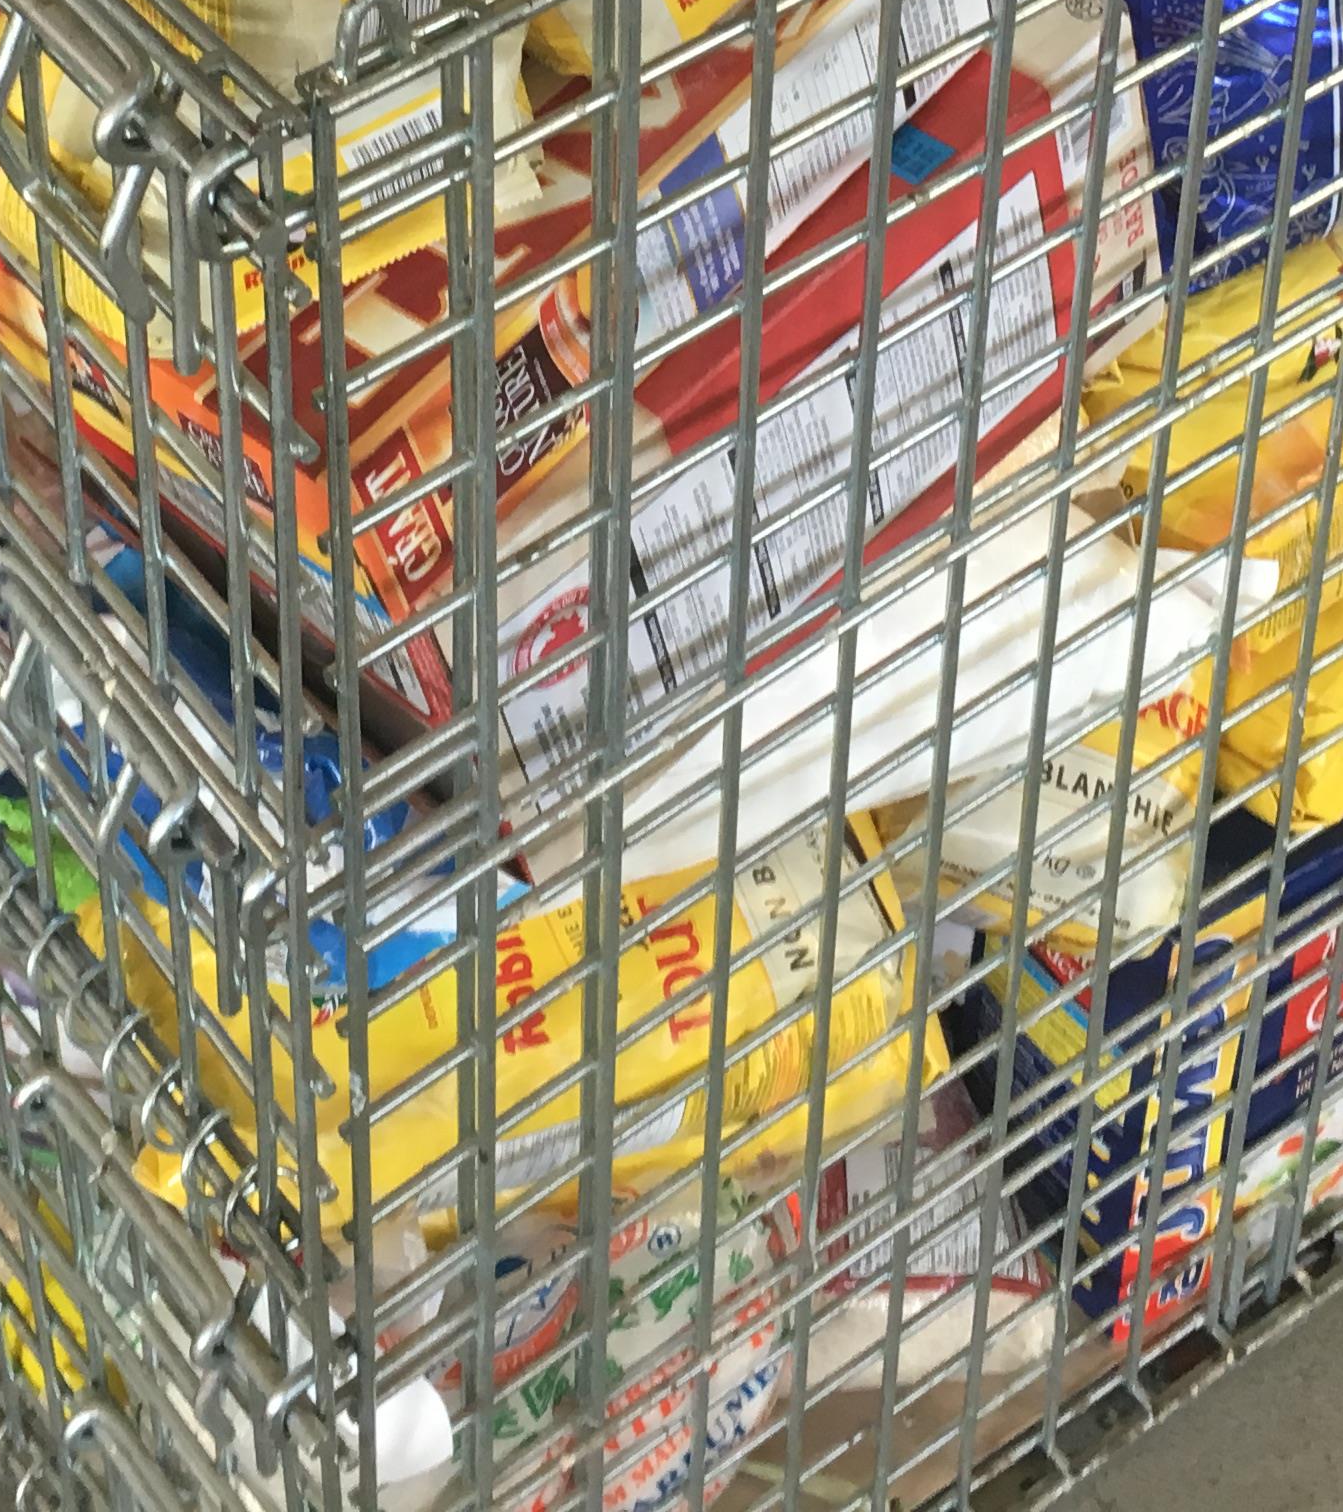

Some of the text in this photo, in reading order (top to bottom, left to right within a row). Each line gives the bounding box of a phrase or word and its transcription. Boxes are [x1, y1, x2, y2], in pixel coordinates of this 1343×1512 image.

[505, 344, 553, 467] NTURE
[1038, 757, 1175, 837] BLANHIE
[495, 924, 551, 1057] Robi
